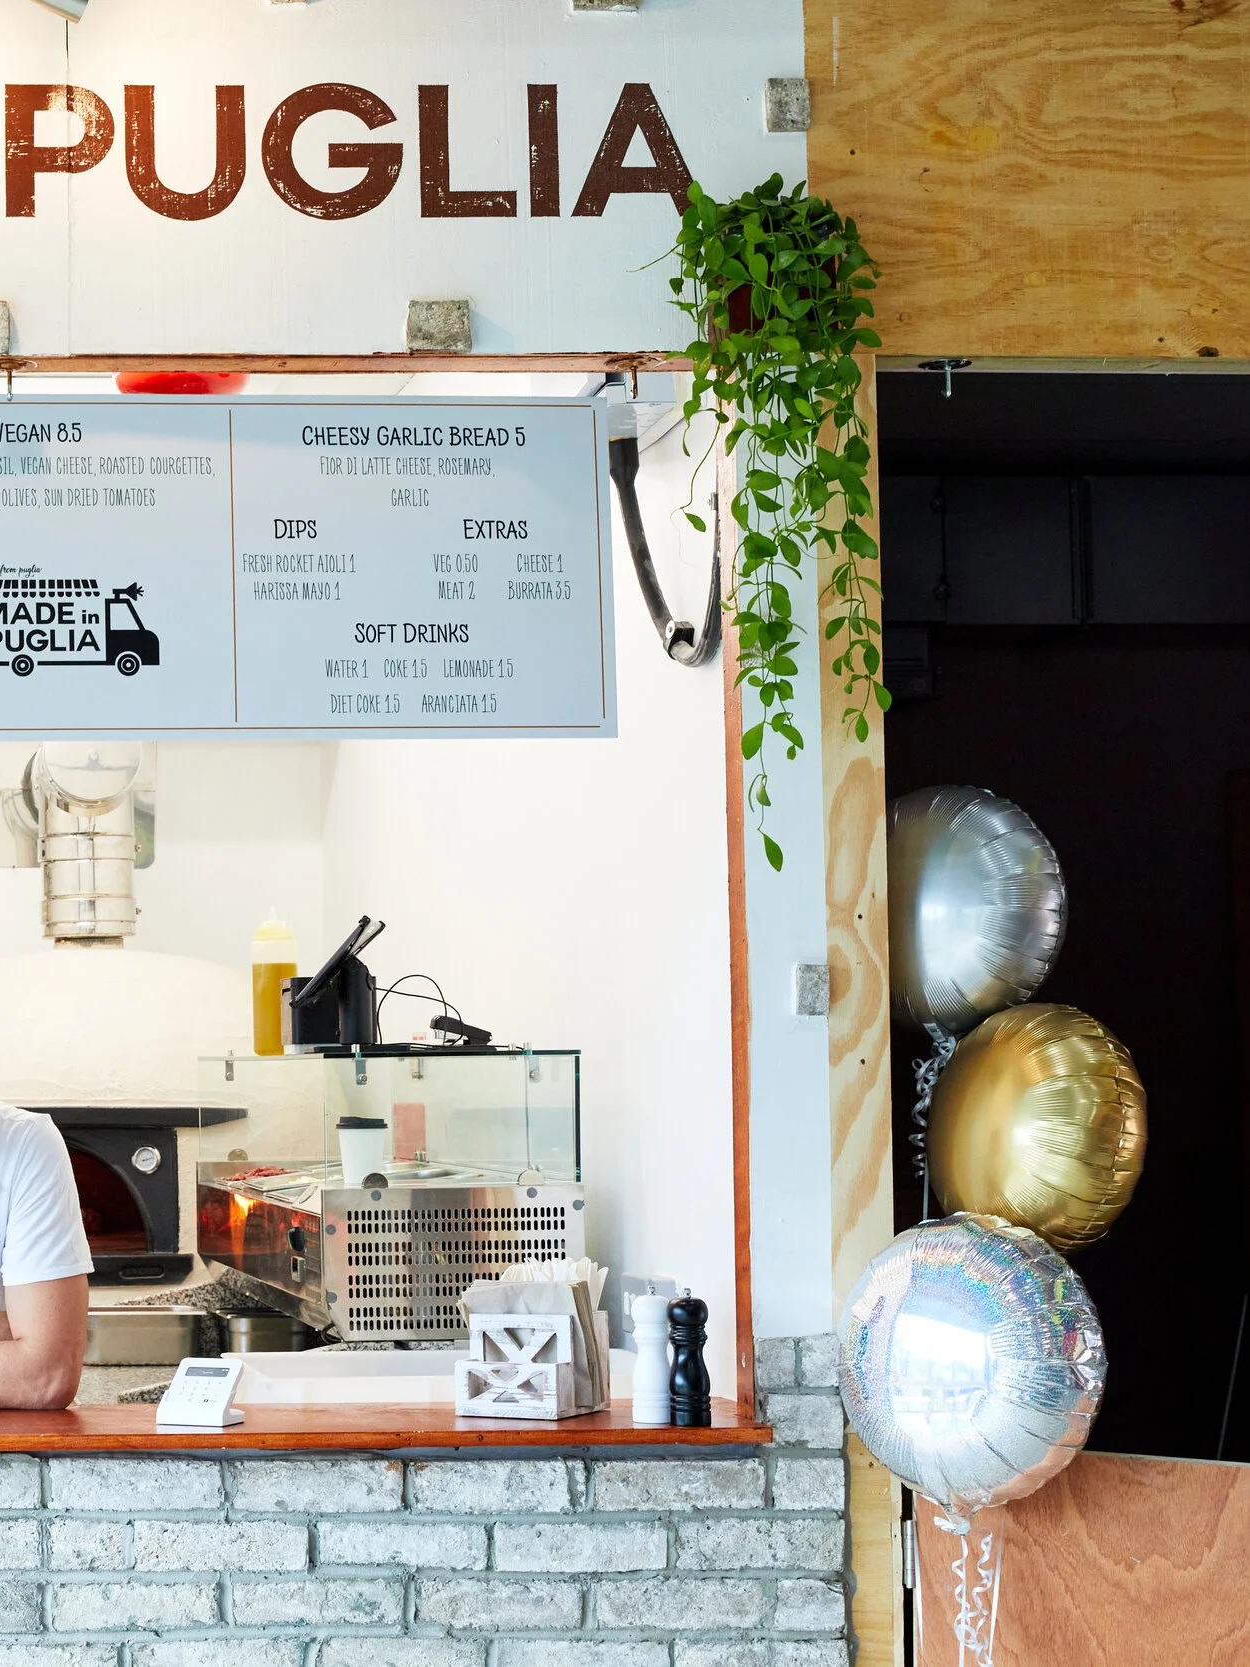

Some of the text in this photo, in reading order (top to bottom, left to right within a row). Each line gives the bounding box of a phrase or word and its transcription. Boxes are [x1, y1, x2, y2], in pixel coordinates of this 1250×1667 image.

[4, 82, 694, 221] PUGLIA
[56, 422, 82, 443] 8.5
[301, 425, 526, 447] CHEESY GARLIC BREAD 5
[20, 455, 52, 476] VEGAN
[56, 456, 97, 478] CHEESE,
[99, 456, 145, 477] ROASTED
[149, 456, 216, 478] COURGETTES,
[319, 455, 496, 478] FIOR DI LATTE CHEESE, ROSEMARY,
[1, 487, 41, 509] OLIVES,
[42, 487, 63, 509] SUN
[66, 487, 99, 509] DRIED
[100, 487, 156, 510] TOMATOES
[390, 487, 430, 508] GARLIC
[273, 518, 318, 540] DIPS
[462, 518, 528, 540] EXTRAS
[242, 552, 357, 574] FRESH ROCKET AIOLI 1
[433, 553, 479, 574] VEG 0.50
[516, 553, 564, 574] CHEESE 1
[253, 580, 342, 601] HARISSA MAYO 1
[438, 579, 476, 601] MEAT 2
[507, 580, 571, 601] BURRATA 3.5
[81, 609, 100, 625] in
[354, 622, 470, 644] SOFT DRINKS
[324, 658, 369, 679] WATER 1
[383, 658, 428, 679] COKE 1.5
[443, 658, 514, 679] LEMONADE 1.5
[330, 692, 401, 714] DIET COKE 1.5
[421, 693, 497, 714] ARANCIATA 1.5
